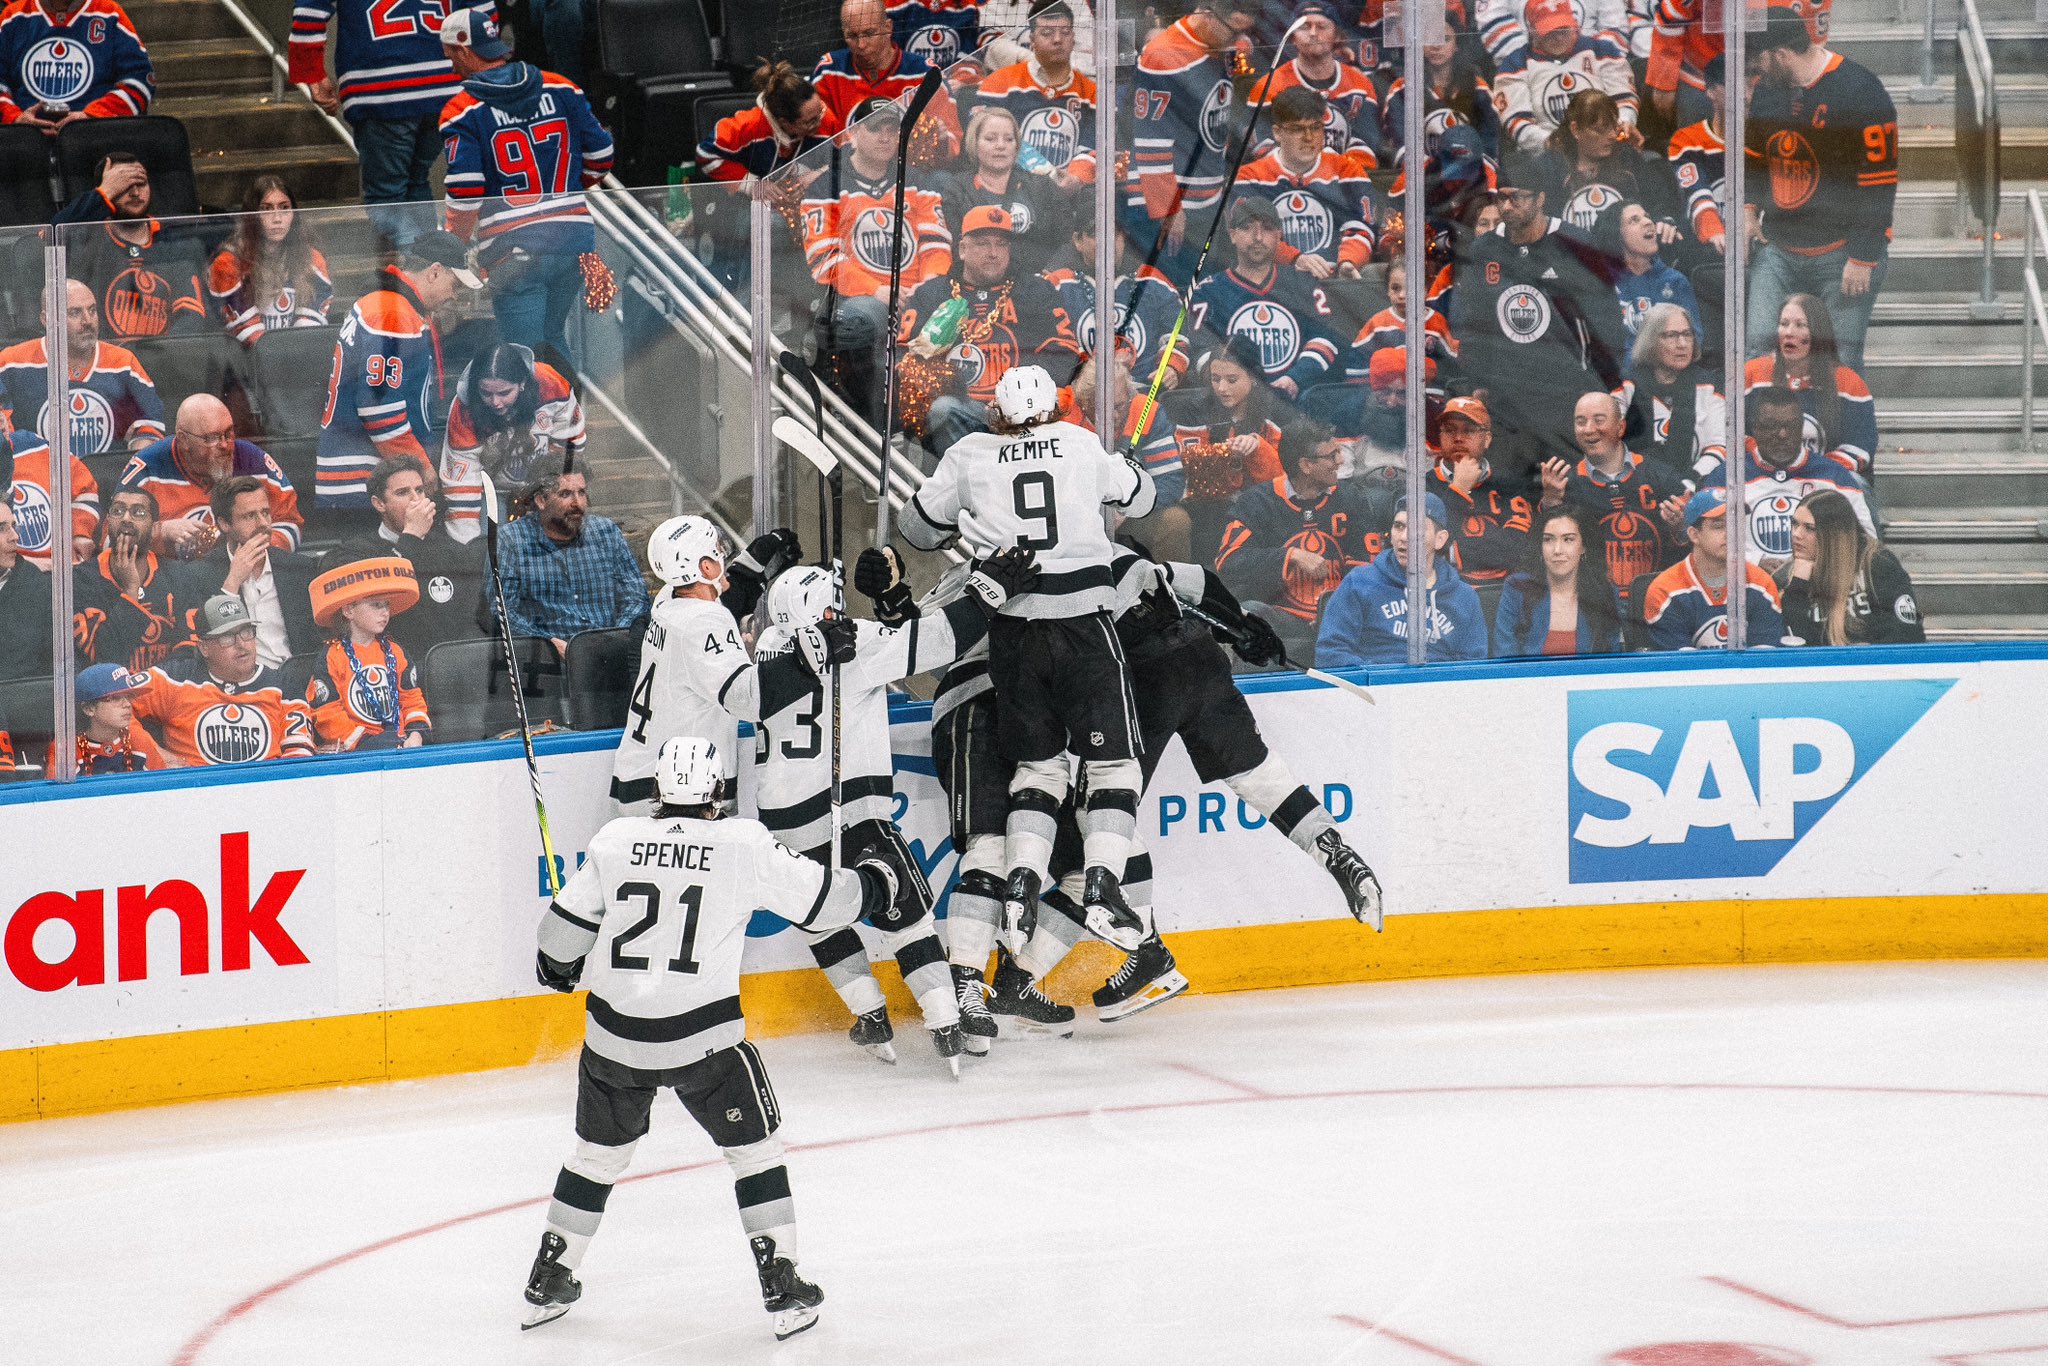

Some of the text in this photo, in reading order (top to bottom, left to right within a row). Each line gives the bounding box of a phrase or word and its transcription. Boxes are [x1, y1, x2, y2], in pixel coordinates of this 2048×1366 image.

[88, 19, 105, 43] C
[33, 59, 83, 82] OILERS
[1135, 88, 1172, 121] 97
[1811, 103, 1828, 129] C
[491, 117, 570, 208] 97
[1678, 163, 1699, 188] 9
[1281, 214, 1325, 236] ILERS
[1485, 261, 1500, 285] C
[1004, 299, 1018, 324] A
[1313, 289, 1331, 315] 2
[1192, 302, 1208, 330] 7
[366, 354, 403, 389] 93
[1026, 397, 1034, 409] 9
[69, 416, 105, 438] LERS
[998, 438, 1063, 463] KEMPE
[1639, 484, 1657, 510] C
[14, 502, 48, 527] LERS
[1011, 470, 1060, 551] 9
[1331, 512, 1348, 537] C
[1756, 515, 1793, 537] OILE
[323, 567, 391, 595] EDMONTON
[777, 612, 789, 623] 33
[704, 628, 743, 656] 44
[205, 723, 261, 749] OILERS
[833, 697, 842, 783] JETSPEED
[677, 772, 689, 785] 21
[1573, 717, 1855, 848] SAP
[1159, 783, 1354, 837] PROD
[630, 843, 714, 872] SPENCE
[4, 831, 311, 992] ank
[610, 880, 705, 976] 21
[760, 1087, 774, 1116] CCM
